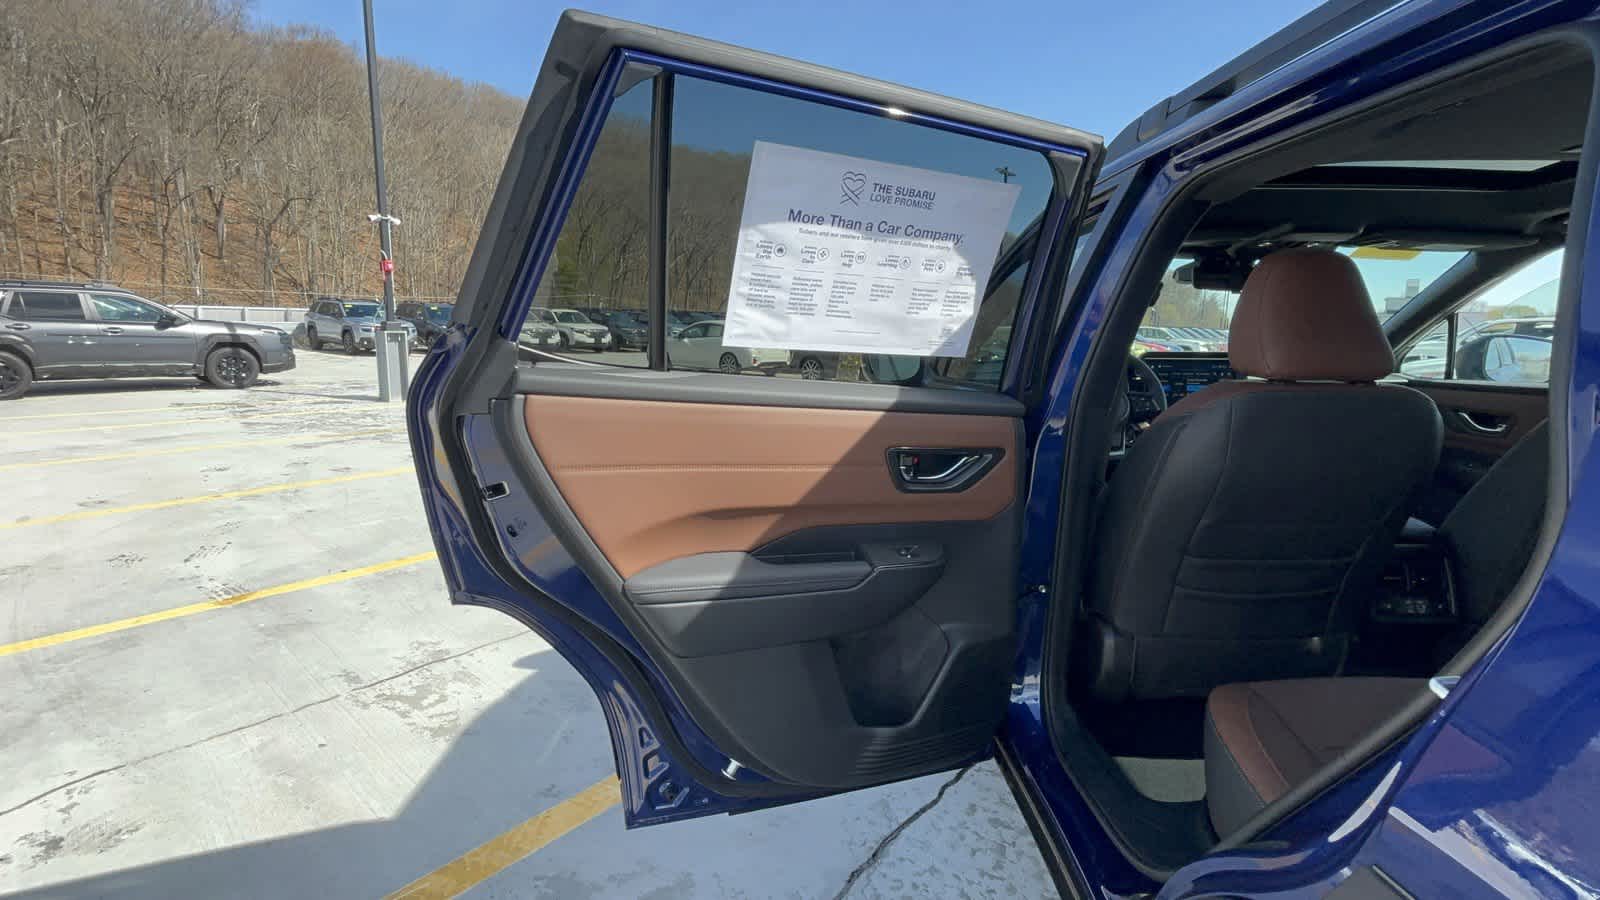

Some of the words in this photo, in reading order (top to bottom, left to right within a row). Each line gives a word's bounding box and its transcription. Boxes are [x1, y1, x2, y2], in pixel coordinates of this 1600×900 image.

[873, 183, 893, 195] THE
[895, 185, 936, 201] SUBARU
[870, 193, 893, 204] LOVE
[894, 196, 935, 210] PROMISE
[788, 208, 825, 225] More
[830, 214, 862, 232] Than
[865, 222, 874, 232] a
[877, 220, 902, 235] Car
[904, 224, 964, 246] Company.
